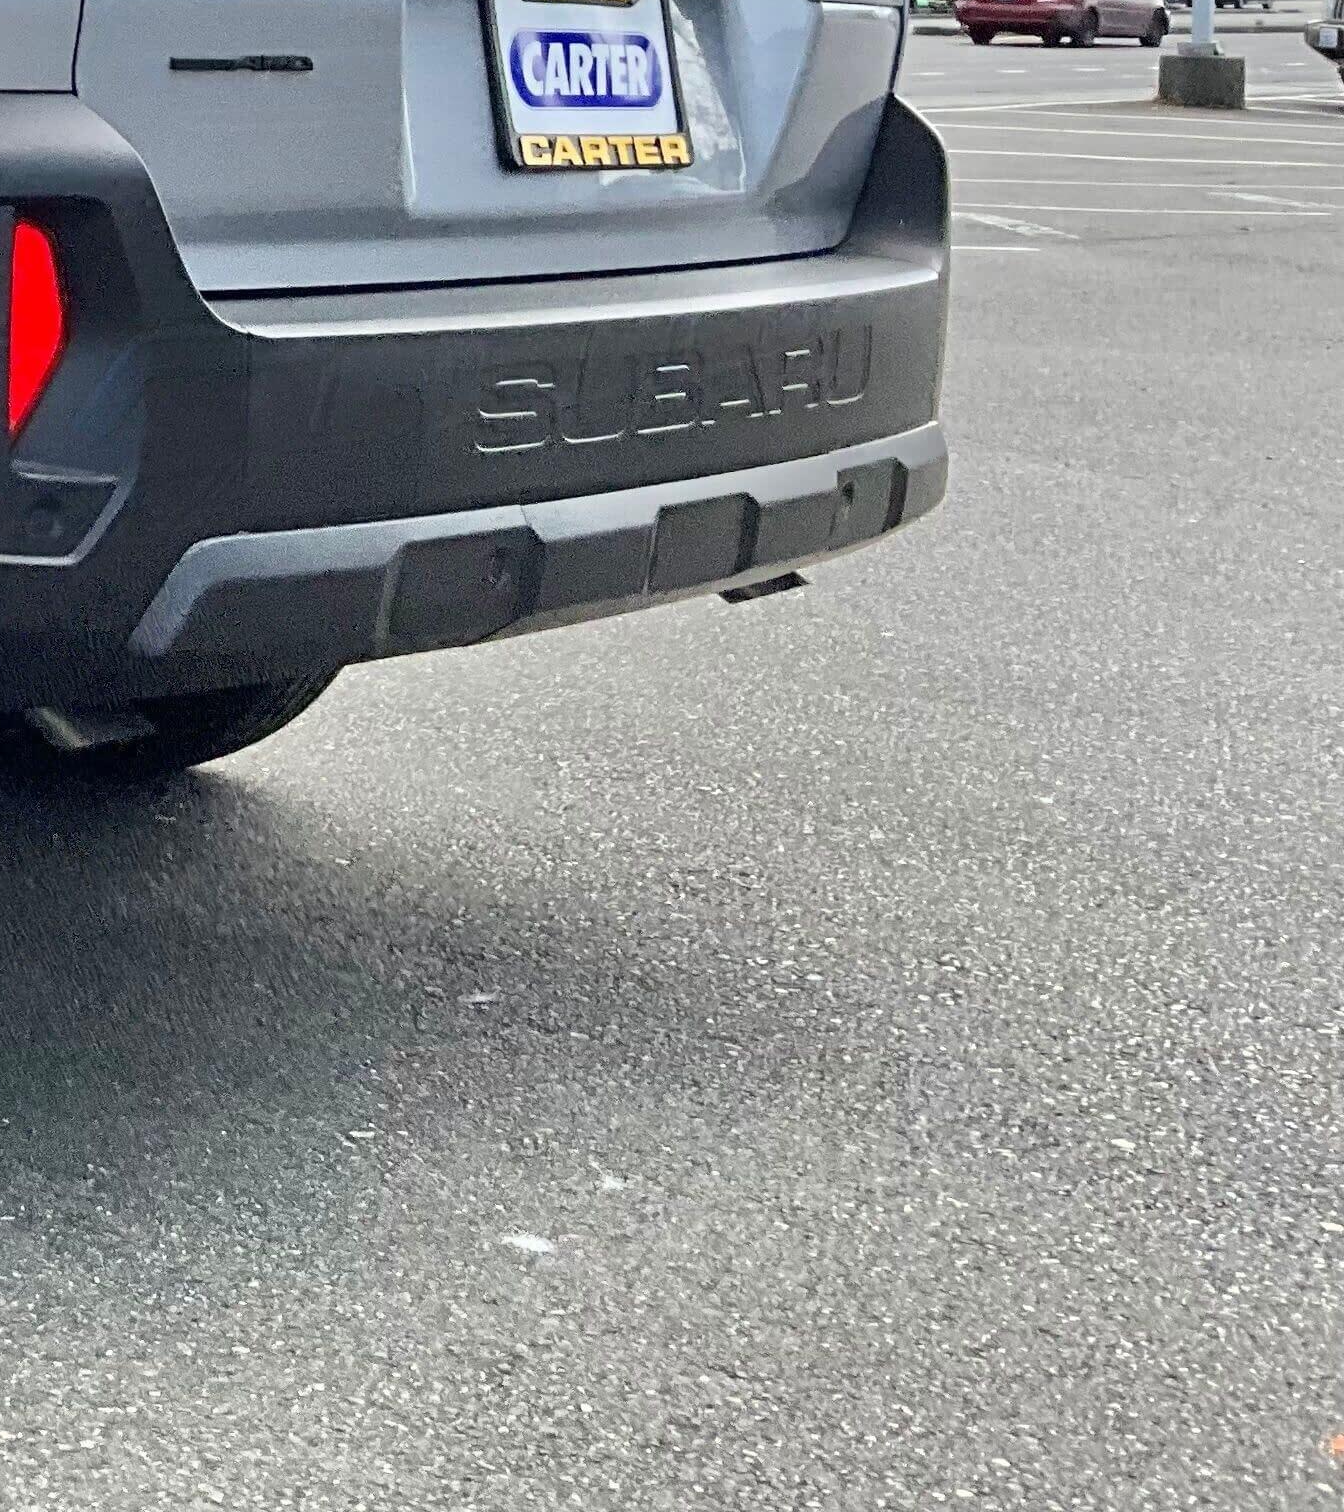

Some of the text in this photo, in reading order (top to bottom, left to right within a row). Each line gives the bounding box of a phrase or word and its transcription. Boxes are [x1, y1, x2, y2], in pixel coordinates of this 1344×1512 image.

[521, 40, 651, 97] CARTER
[519, 134, 691, 166] CARTER
[470, 324, 874, 454] SUBARU
